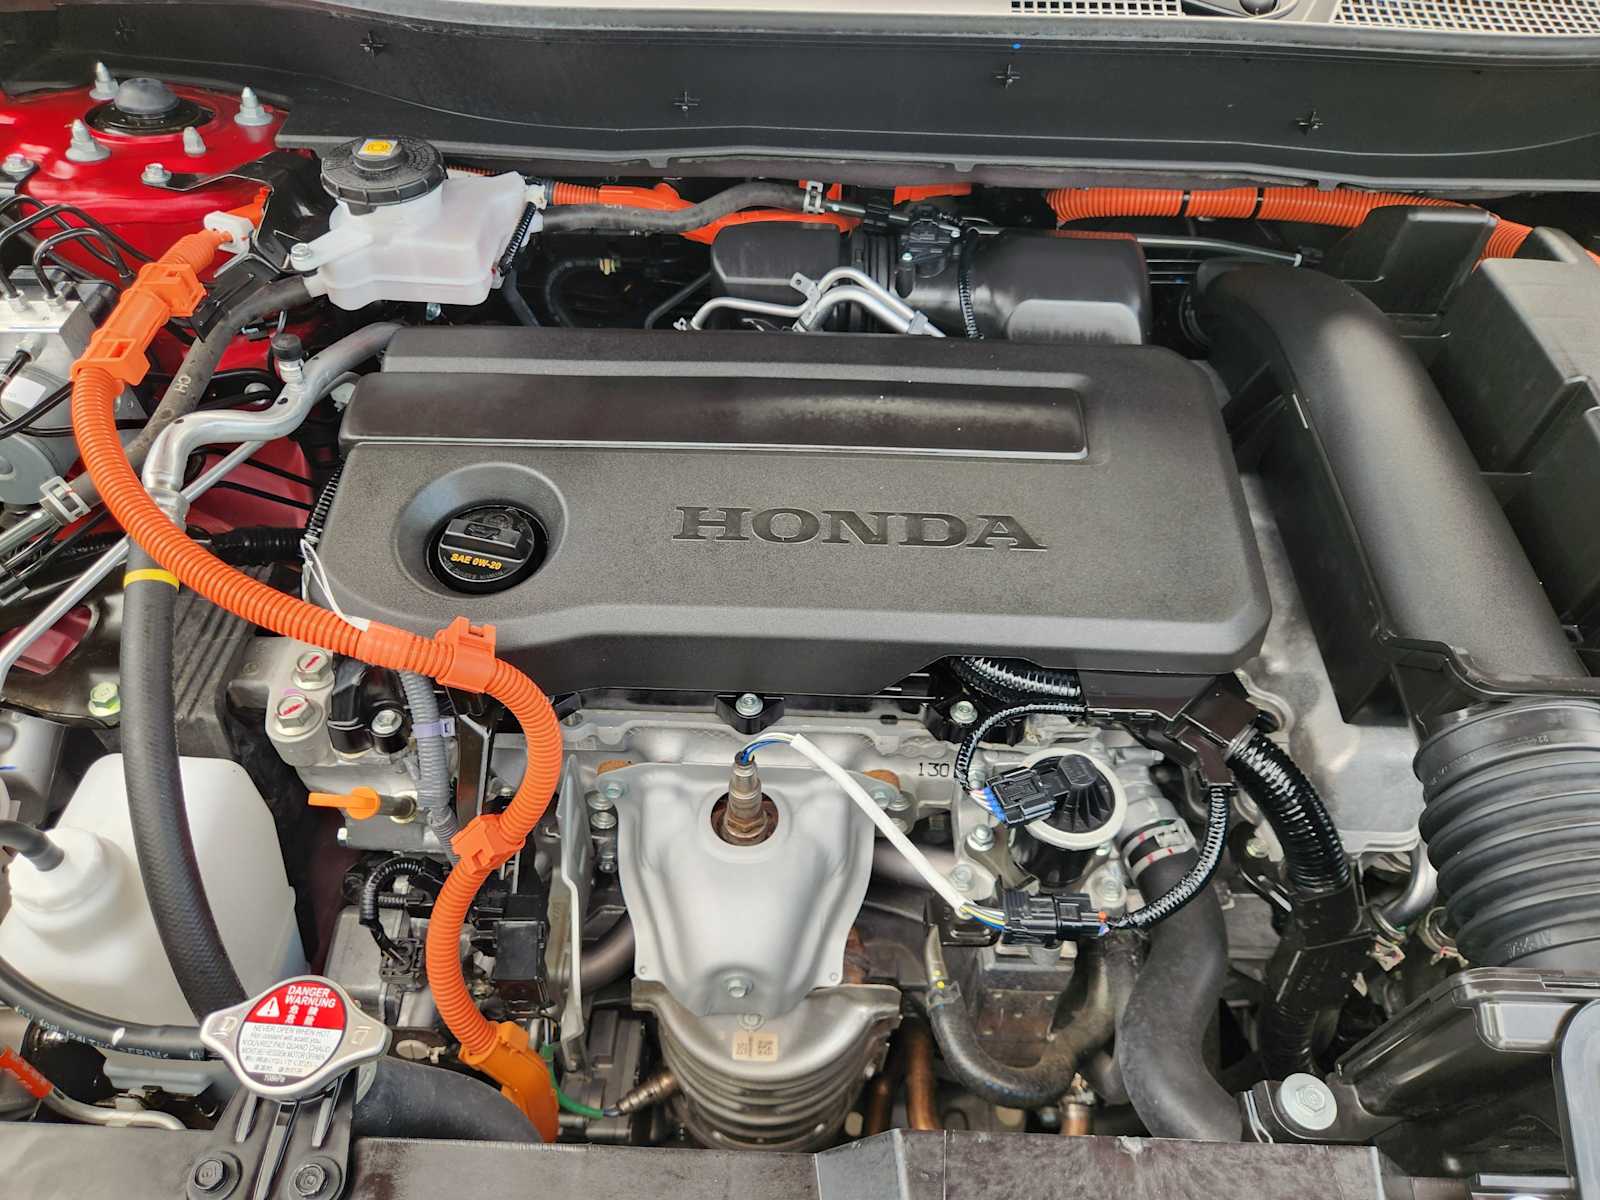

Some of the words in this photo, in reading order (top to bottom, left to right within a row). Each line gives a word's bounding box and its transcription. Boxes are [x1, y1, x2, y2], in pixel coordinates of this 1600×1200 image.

[671, 505, 1048, 551] HONDA
[450, 553, 472, 564] SAE
[472, 558, 502, 570] 0W-20
[918, 762, 950, 777] 130
[287, 985, 330, 998] DANGER
[285, 996, 336, 1008] WARNUNG
